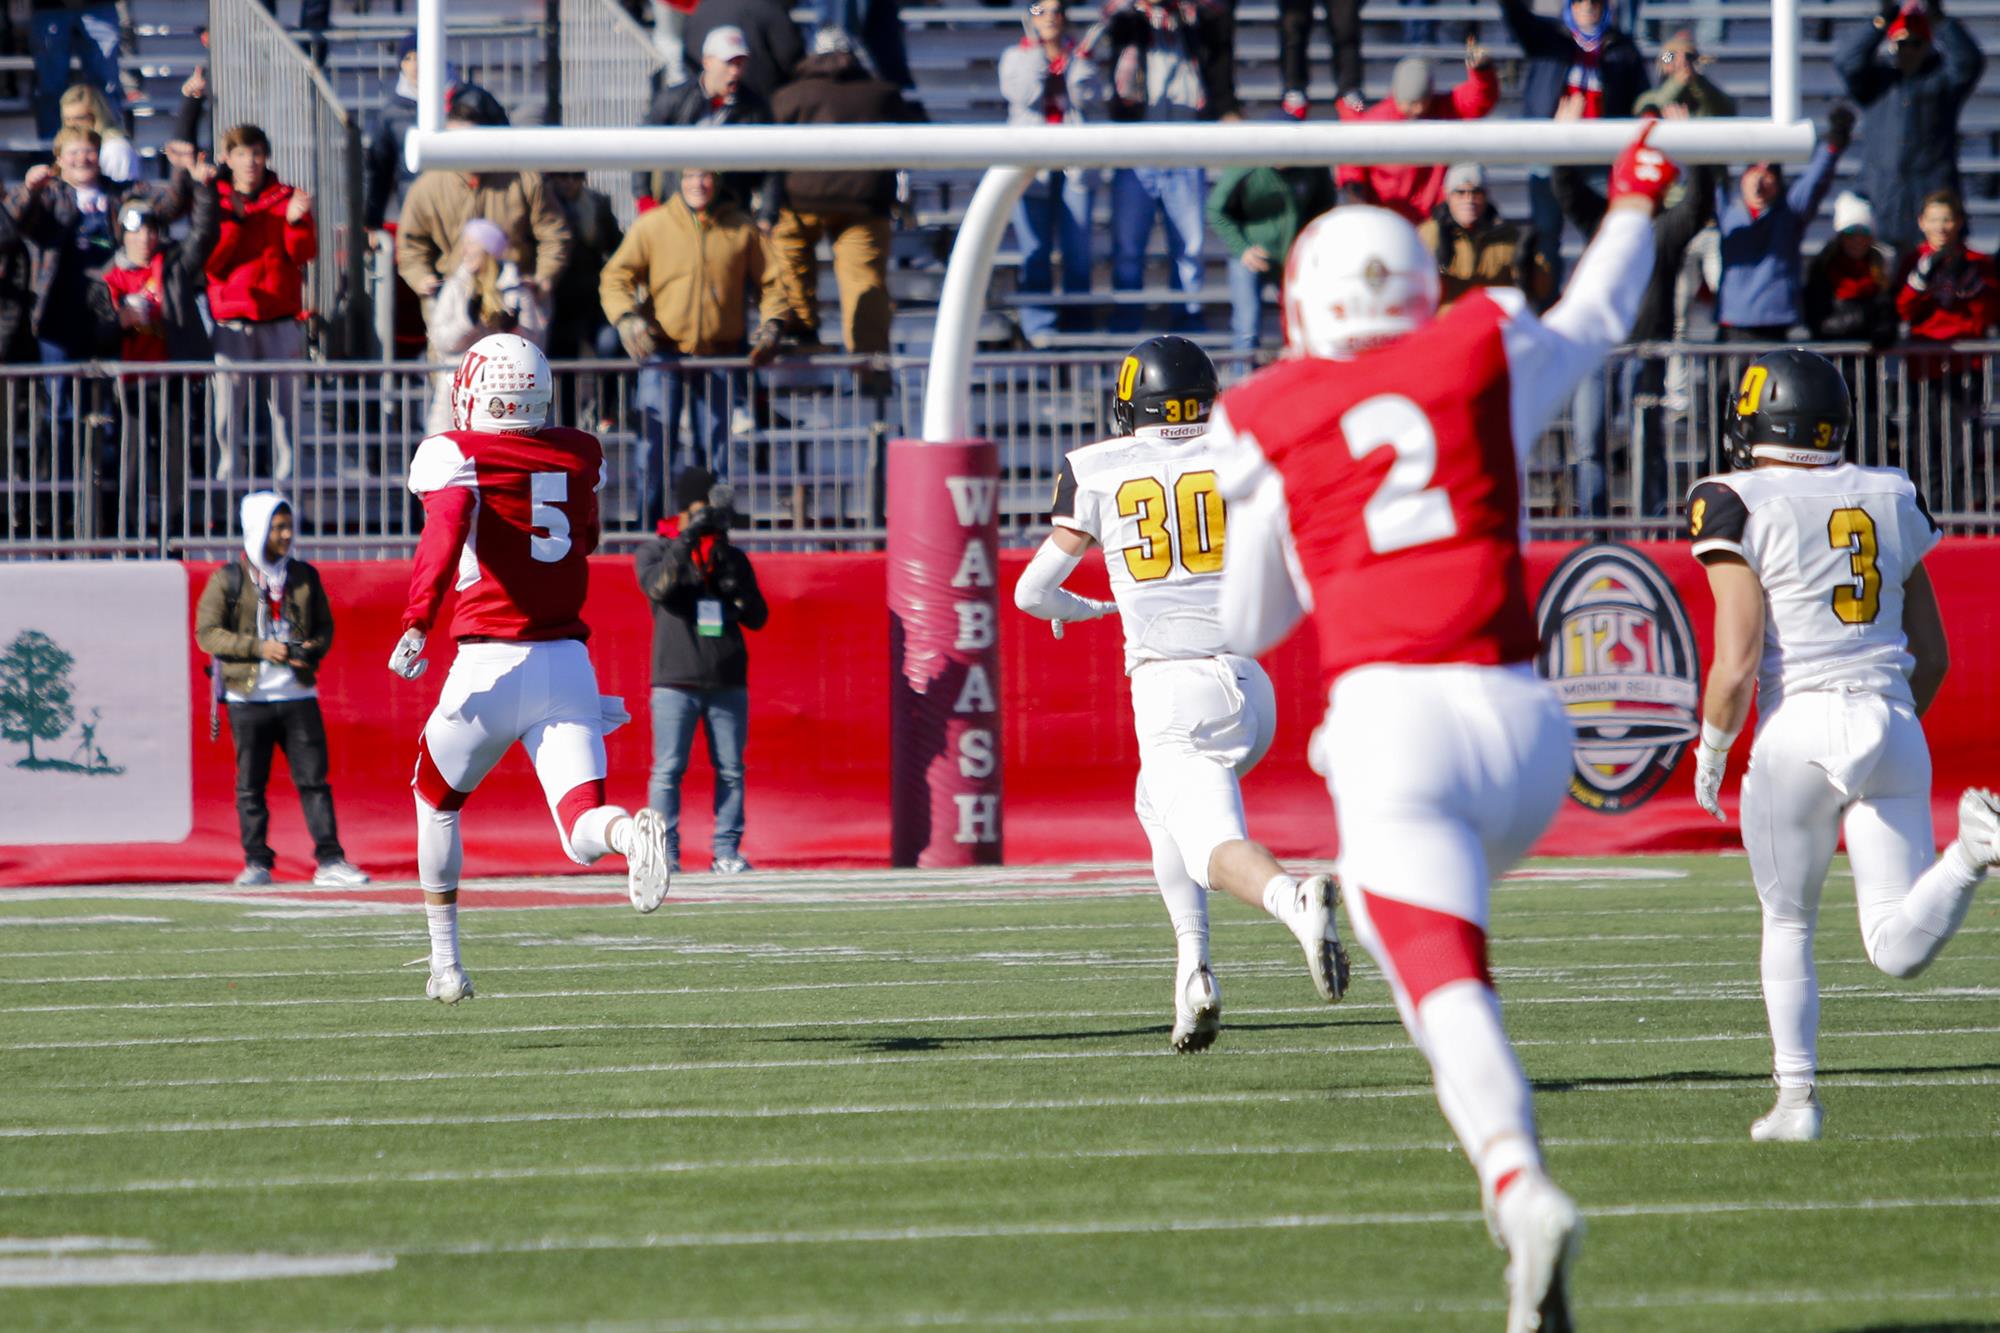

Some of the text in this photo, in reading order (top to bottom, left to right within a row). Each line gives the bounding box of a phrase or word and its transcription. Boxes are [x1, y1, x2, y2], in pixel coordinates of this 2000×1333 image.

[1160, 425, 1203, 437] Riddell
[1164, 399, 1198, 422] 30
[1813, 421, 1832, 448] 3
[1340, 393, 1457, 554] 2
[1787, 451, 1833, 463] Riddell
[530, 472, 572, 563] 5
[1116, 470, 1227, 582] 30
[1827, 507, 1882, 624] 3
[945, 475, 999, 844] WABASH
